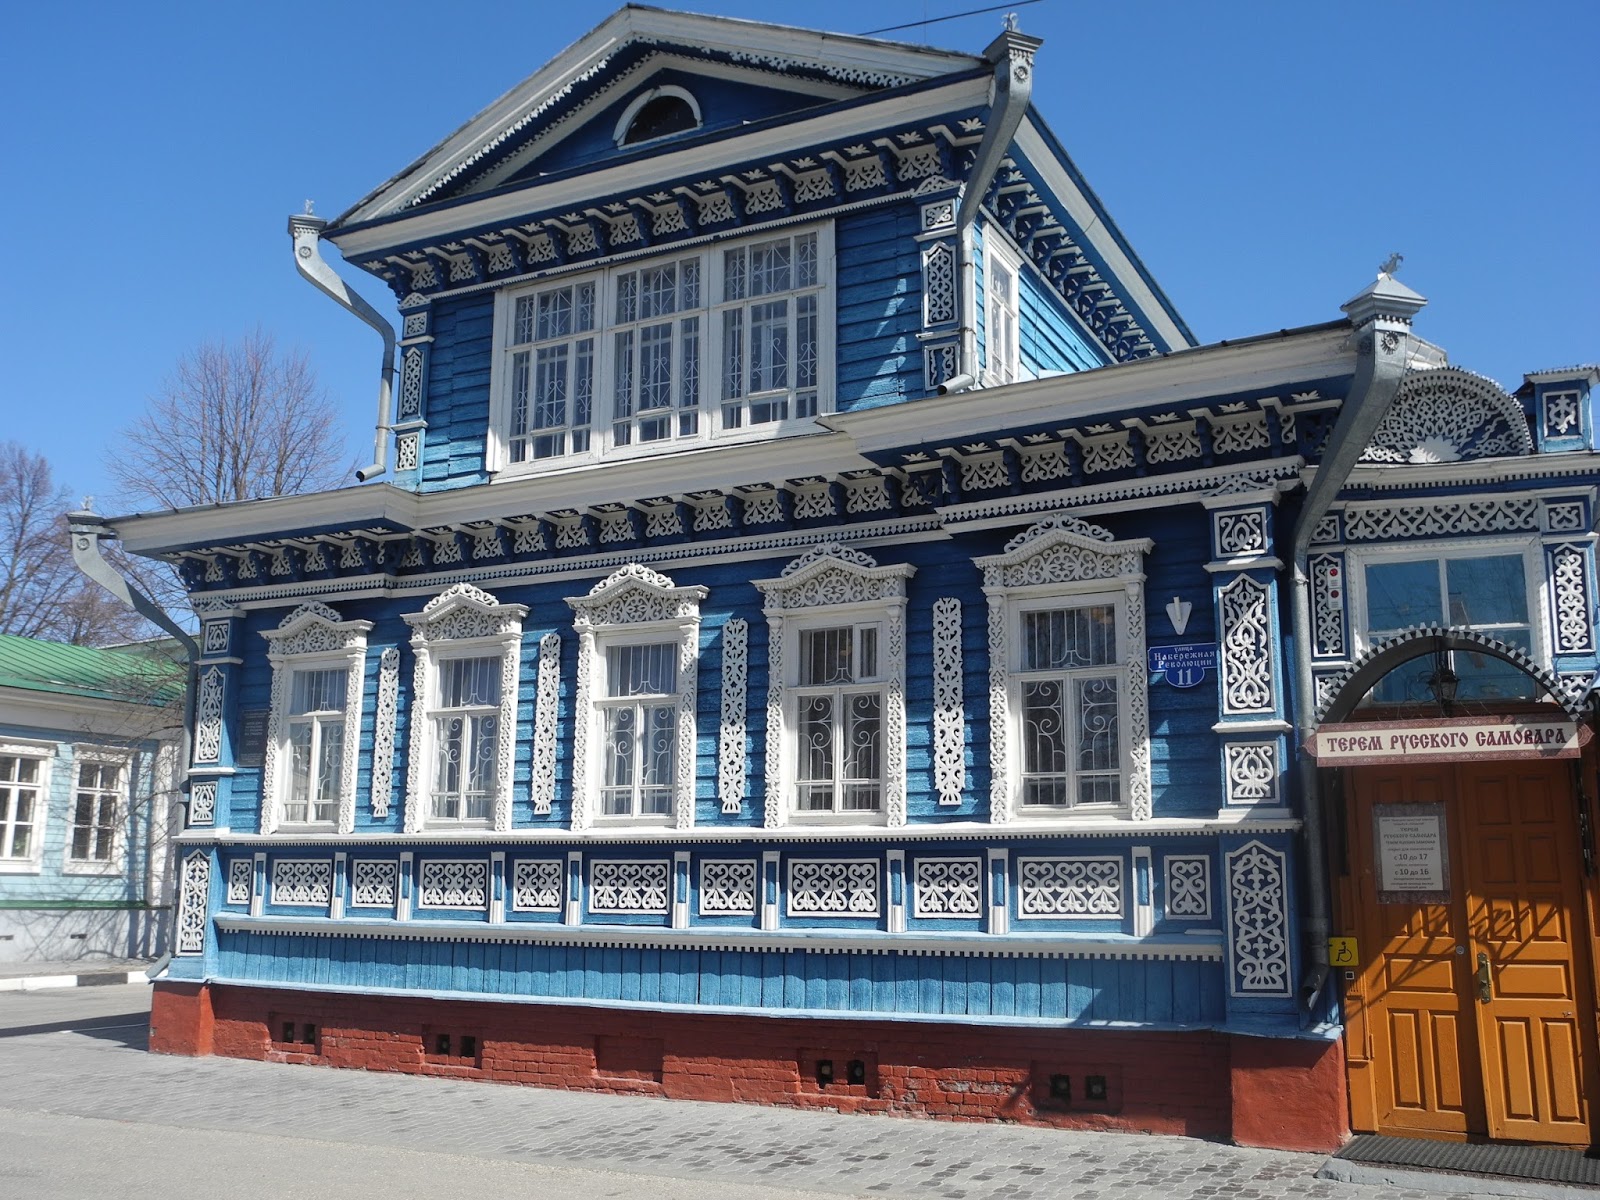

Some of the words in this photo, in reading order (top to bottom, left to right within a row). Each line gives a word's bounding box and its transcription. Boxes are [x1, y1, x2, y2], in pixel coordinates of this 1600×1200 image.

[1177, 668, 1193, 685] 11
[1327, 736, 1383, 752] ТЕРЕМ
[1390, 732, 1469, 753] РУССКОГО
[1475, 728, 1567, 747] САМОВАРА
